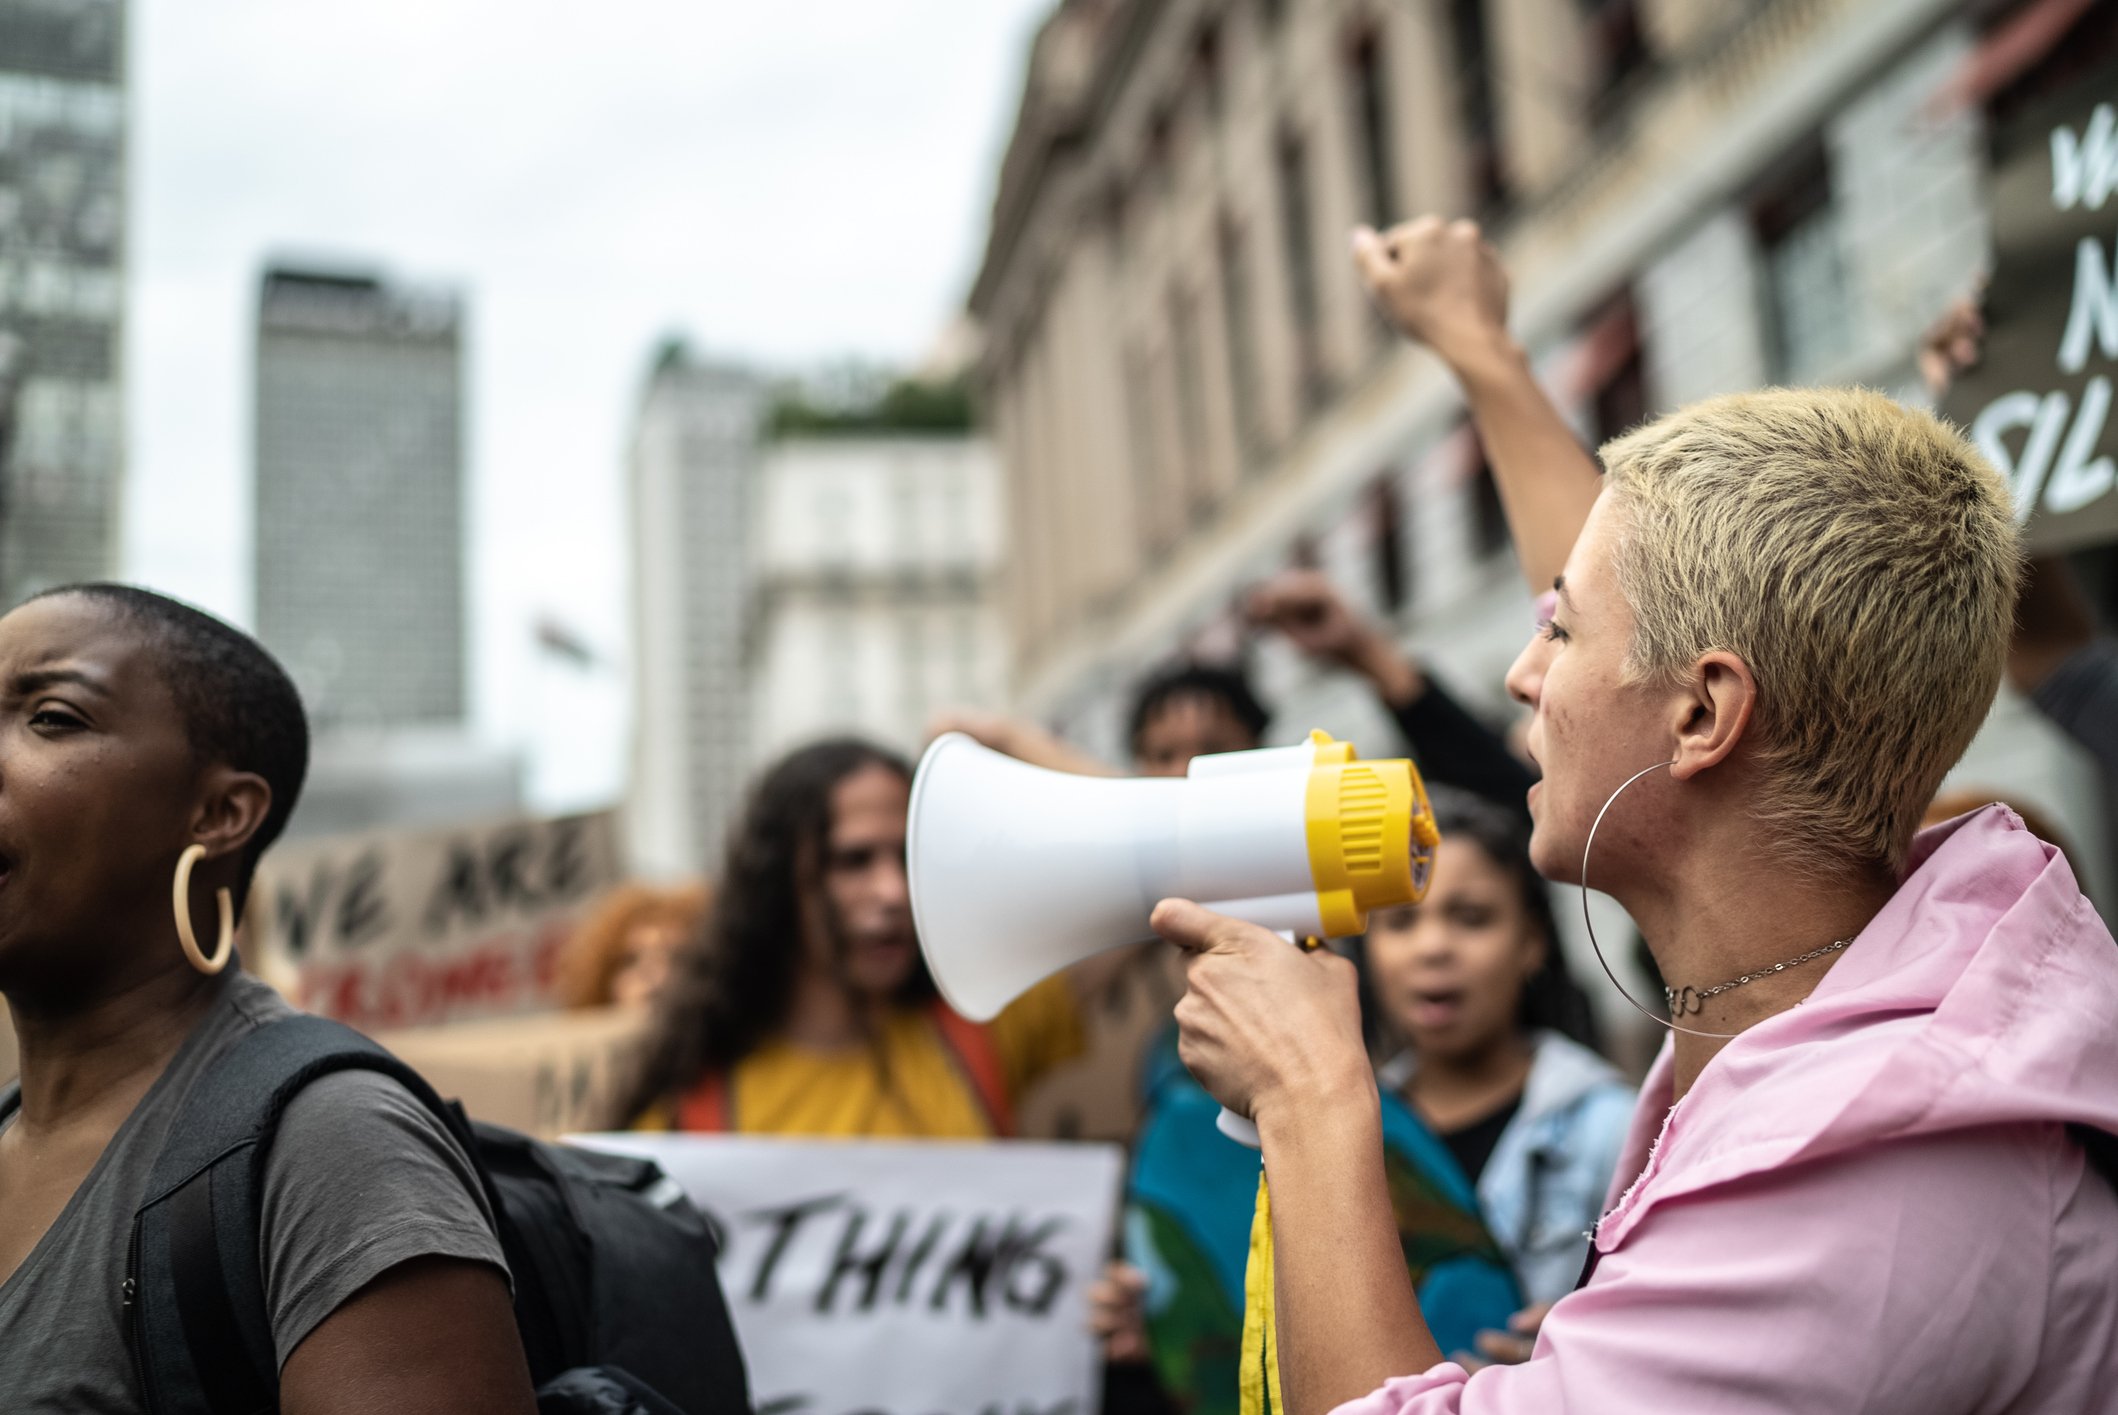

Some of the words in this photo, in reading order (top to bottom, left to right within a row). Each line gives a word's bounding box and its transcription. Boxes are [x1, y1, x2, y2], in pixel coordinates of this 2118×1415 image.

[276, 844, 394, 960] WE
[424, 816, 594, 942] ARE
[704, 1190, 1080, 1322] THING
